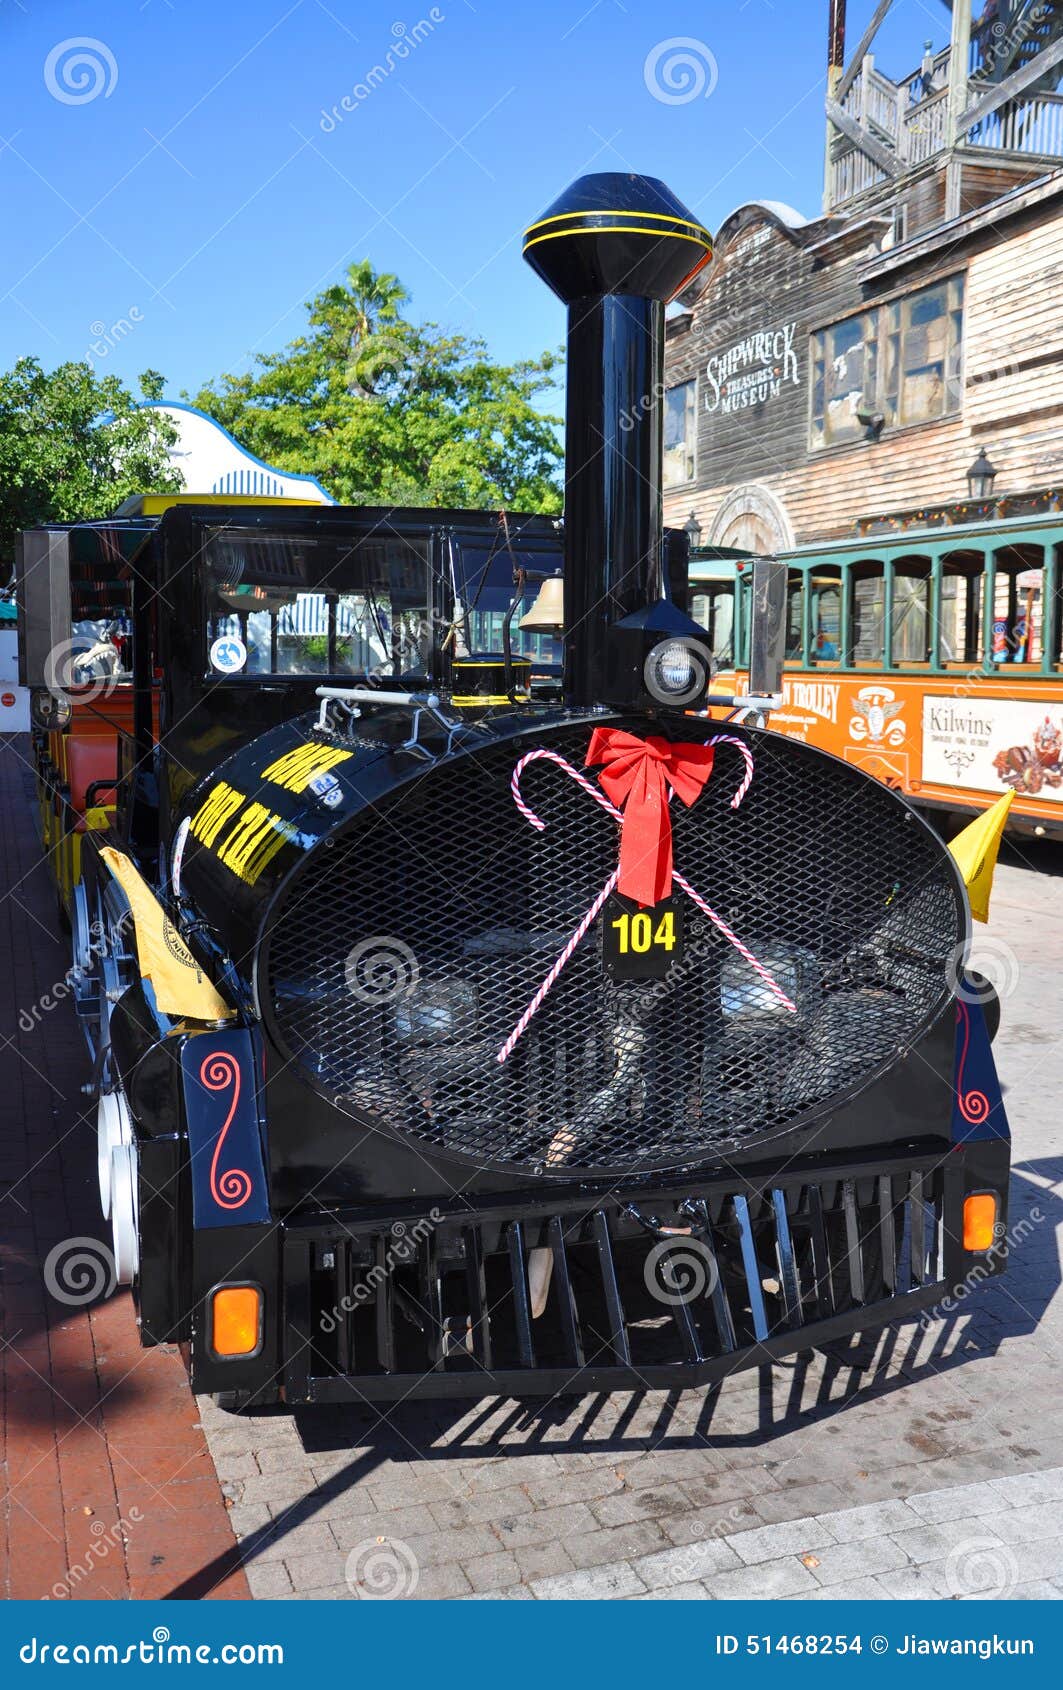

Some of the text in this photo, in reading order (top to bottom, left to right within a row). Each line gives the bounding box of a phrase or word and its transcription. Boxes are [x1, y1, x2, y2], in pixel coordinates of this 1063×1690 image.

[704, 322, 800, 412] SHIPWRECK
[726, 366, 774, 396] TREASURES
[721, 379, 782, 414] MUSEUM
[792, 682, 841, 724] TROLLEY
[930, 707, 993, 736] Kilwins
[189, 781, 247, 850] TOUR
[216, 802, 299, 888] TRAIN
[612, 912, 676, 953] 104
